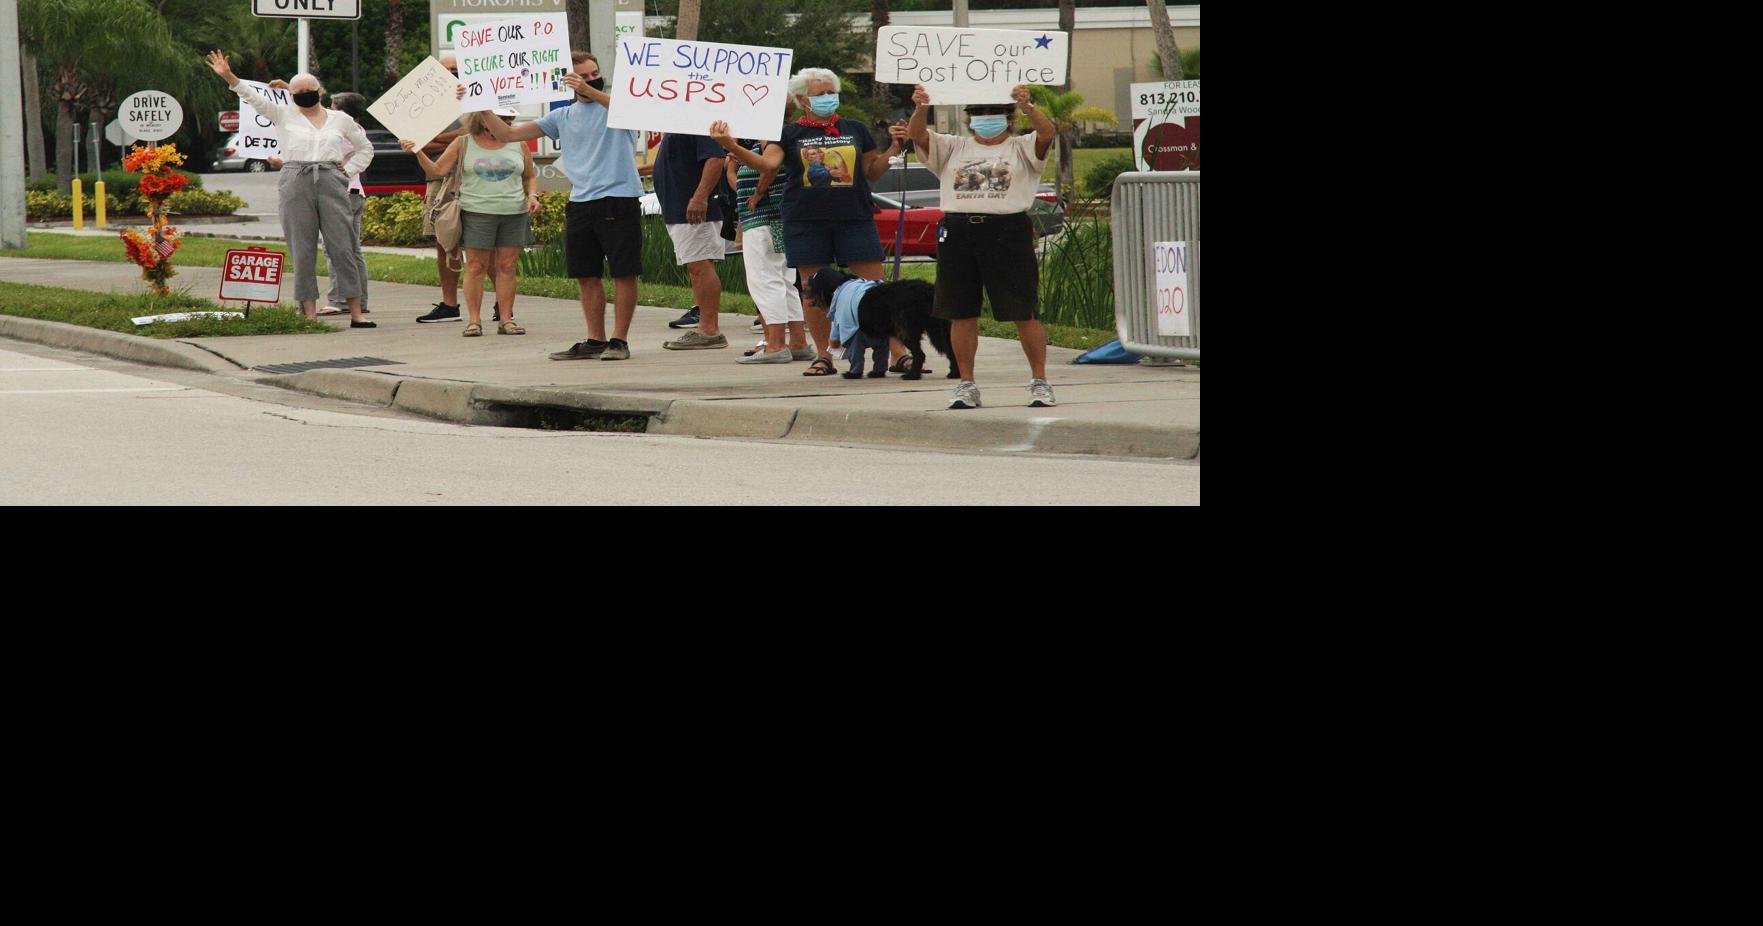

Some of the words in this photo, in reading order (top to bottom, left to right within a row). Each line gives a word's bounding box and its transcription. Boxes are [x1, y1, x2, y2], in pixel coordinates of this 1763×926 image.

[274, 0, 336, 11] ONLY
[460, 27, 494, 48] SAVE
[498, 24, 526, 43] OUR
[887, 32, 976, 58] SAVE
[993, 44, 1033, 57] our
[464, 54, 505, 76] SECURE
[508, 51, 531, 69] OUR
[532, 48, 560, 65] RIGHT
[623, 42, 661, 67] WE
[673, 44, 791, 77] SUPPORT
[687, 71, 713, 81] the
[896, 58, 958, 82] Post
[965, 59, 1055, 83] Office
[468, 81, 483, 97] TO
[629, 77, 726, 104] USPS
[133, 96, 167, 108] DRIVE
[129, 110, 171, 122] SAFELY
[956, 192, 985, 200] EARTH
[231, 255, 279, 268] GARAGE
[230, 265, 278, 282] SALE
